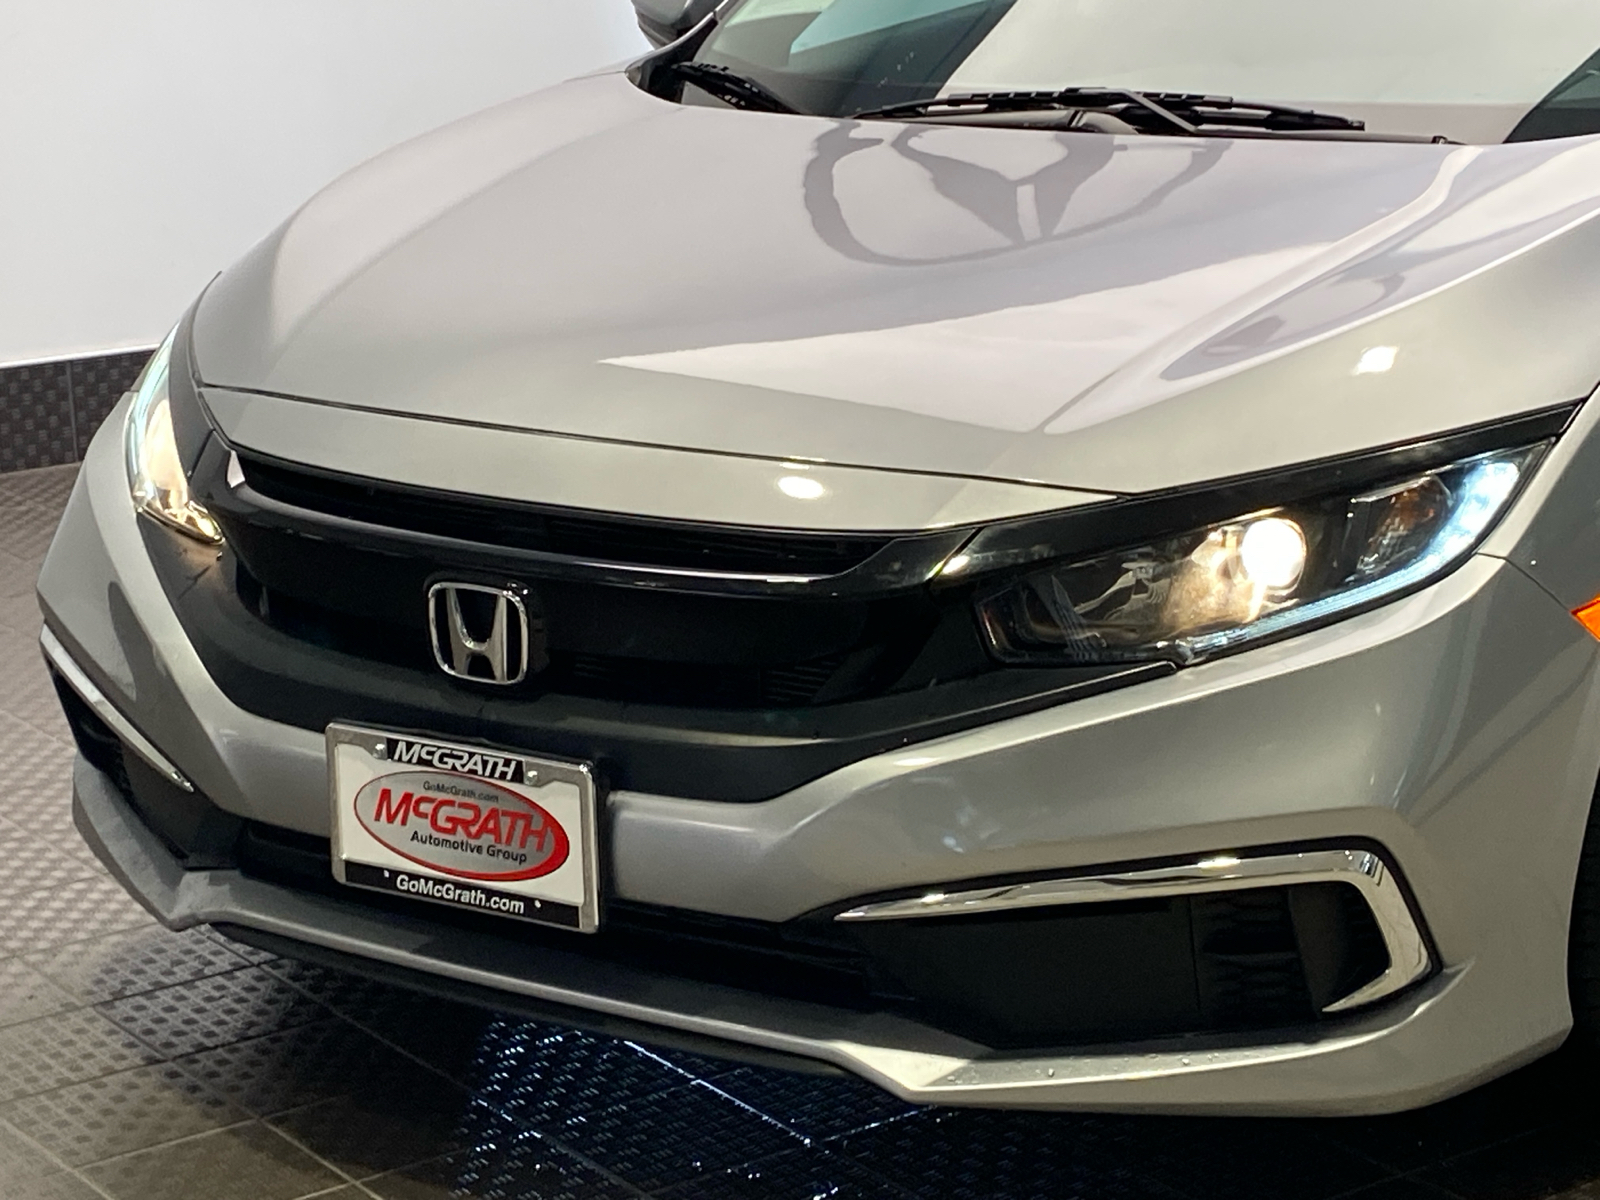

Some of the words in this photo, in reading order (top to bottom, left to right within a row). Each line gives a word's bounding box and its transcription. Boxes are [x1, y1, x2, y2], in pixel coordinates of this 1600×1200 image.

[423, 781, 499, 802] GoMcGrath.com
[410, 830, 483, 855] Automotive
[486, 845, 528, 866] Group
[396, 874, 525, 914] GoMcGrath.com
